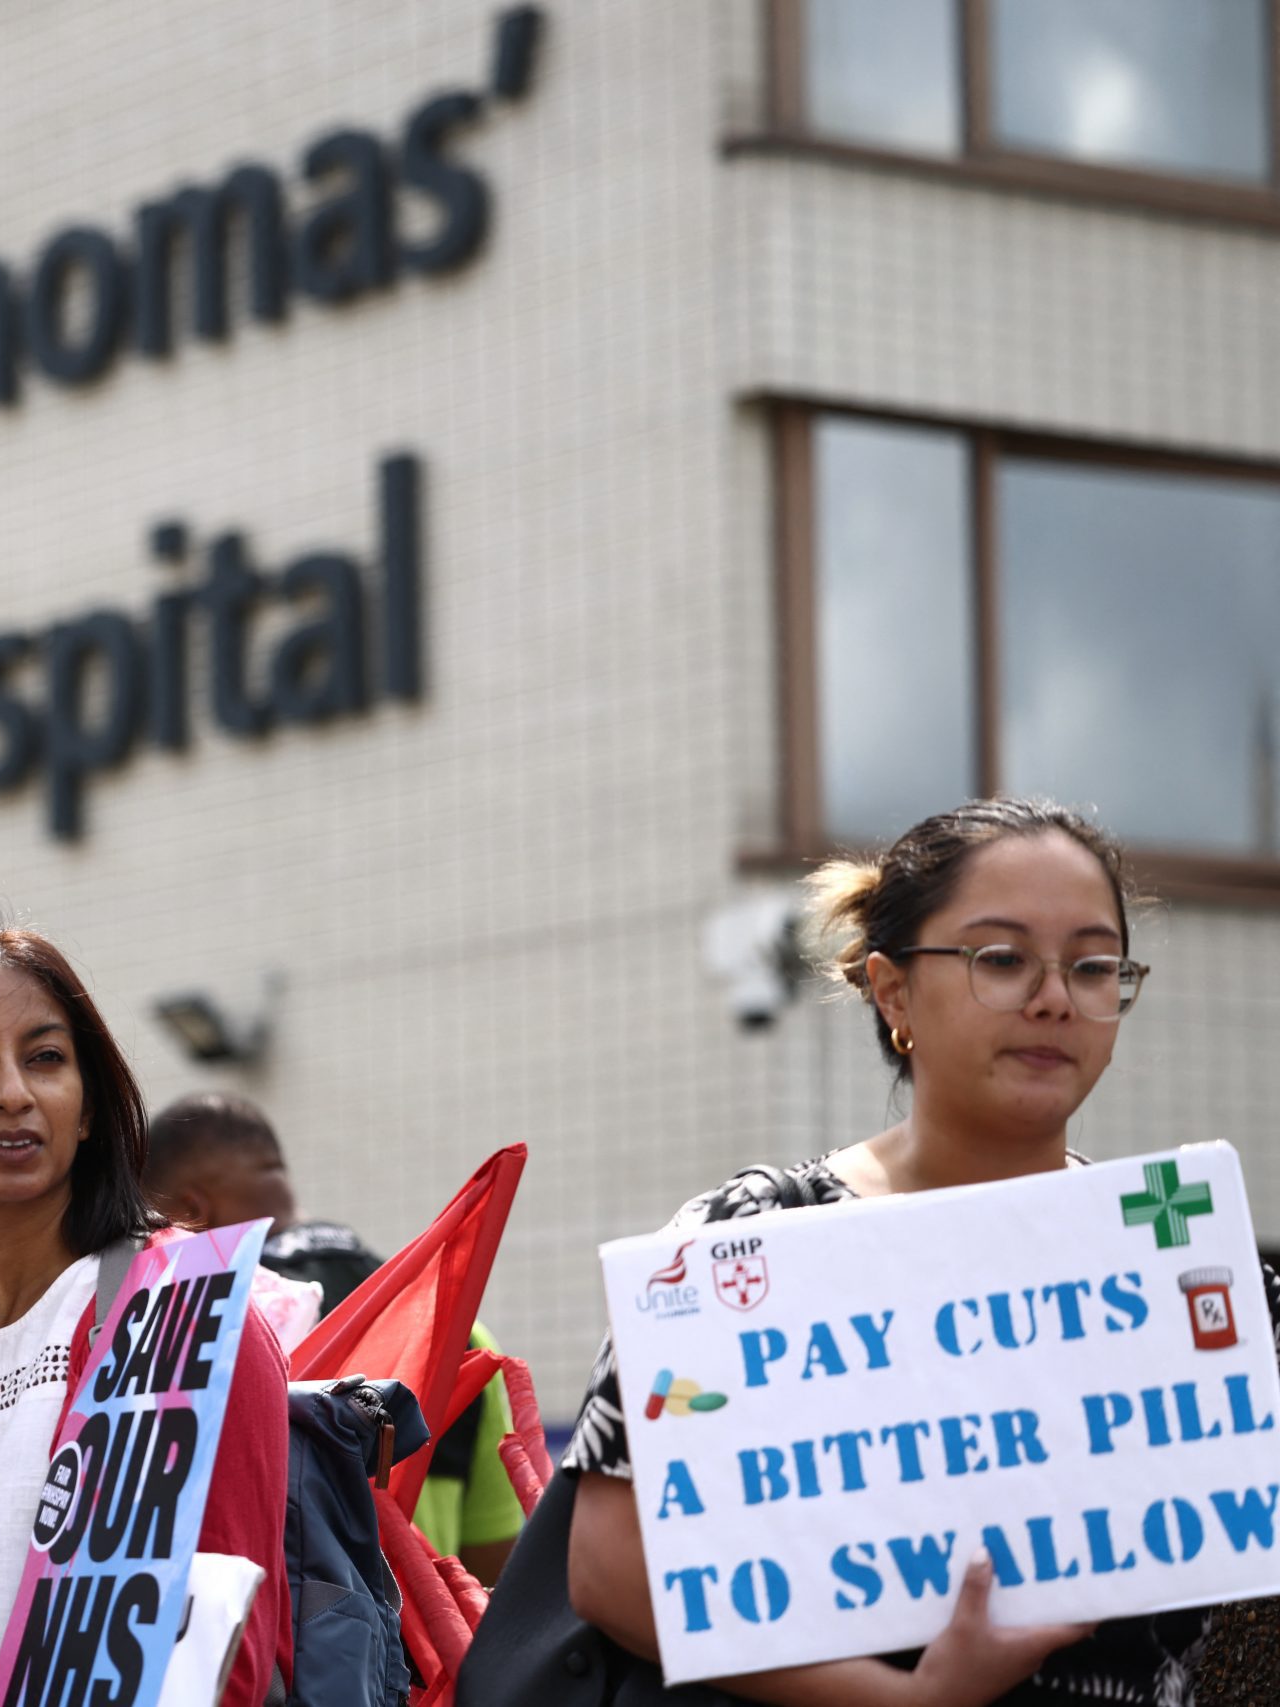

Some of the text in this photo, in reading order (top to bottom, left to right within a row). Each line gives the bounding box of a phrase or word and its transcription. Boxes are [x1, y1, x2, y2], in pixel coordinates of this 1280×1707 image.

[711, 1237, 762, 1260] GHP
[93, 1271, 236, 1403] SAVE
[738, 1271, 1149, 1387] PAY CUTS
[47, 1407, 198, 1566] OUR
[657, 1374, 1274, 1519] A BITTER PILL
[664, 1484, 1280, 1633] TO SWALLOW
[2, 1572, 160, 1707] NHS
